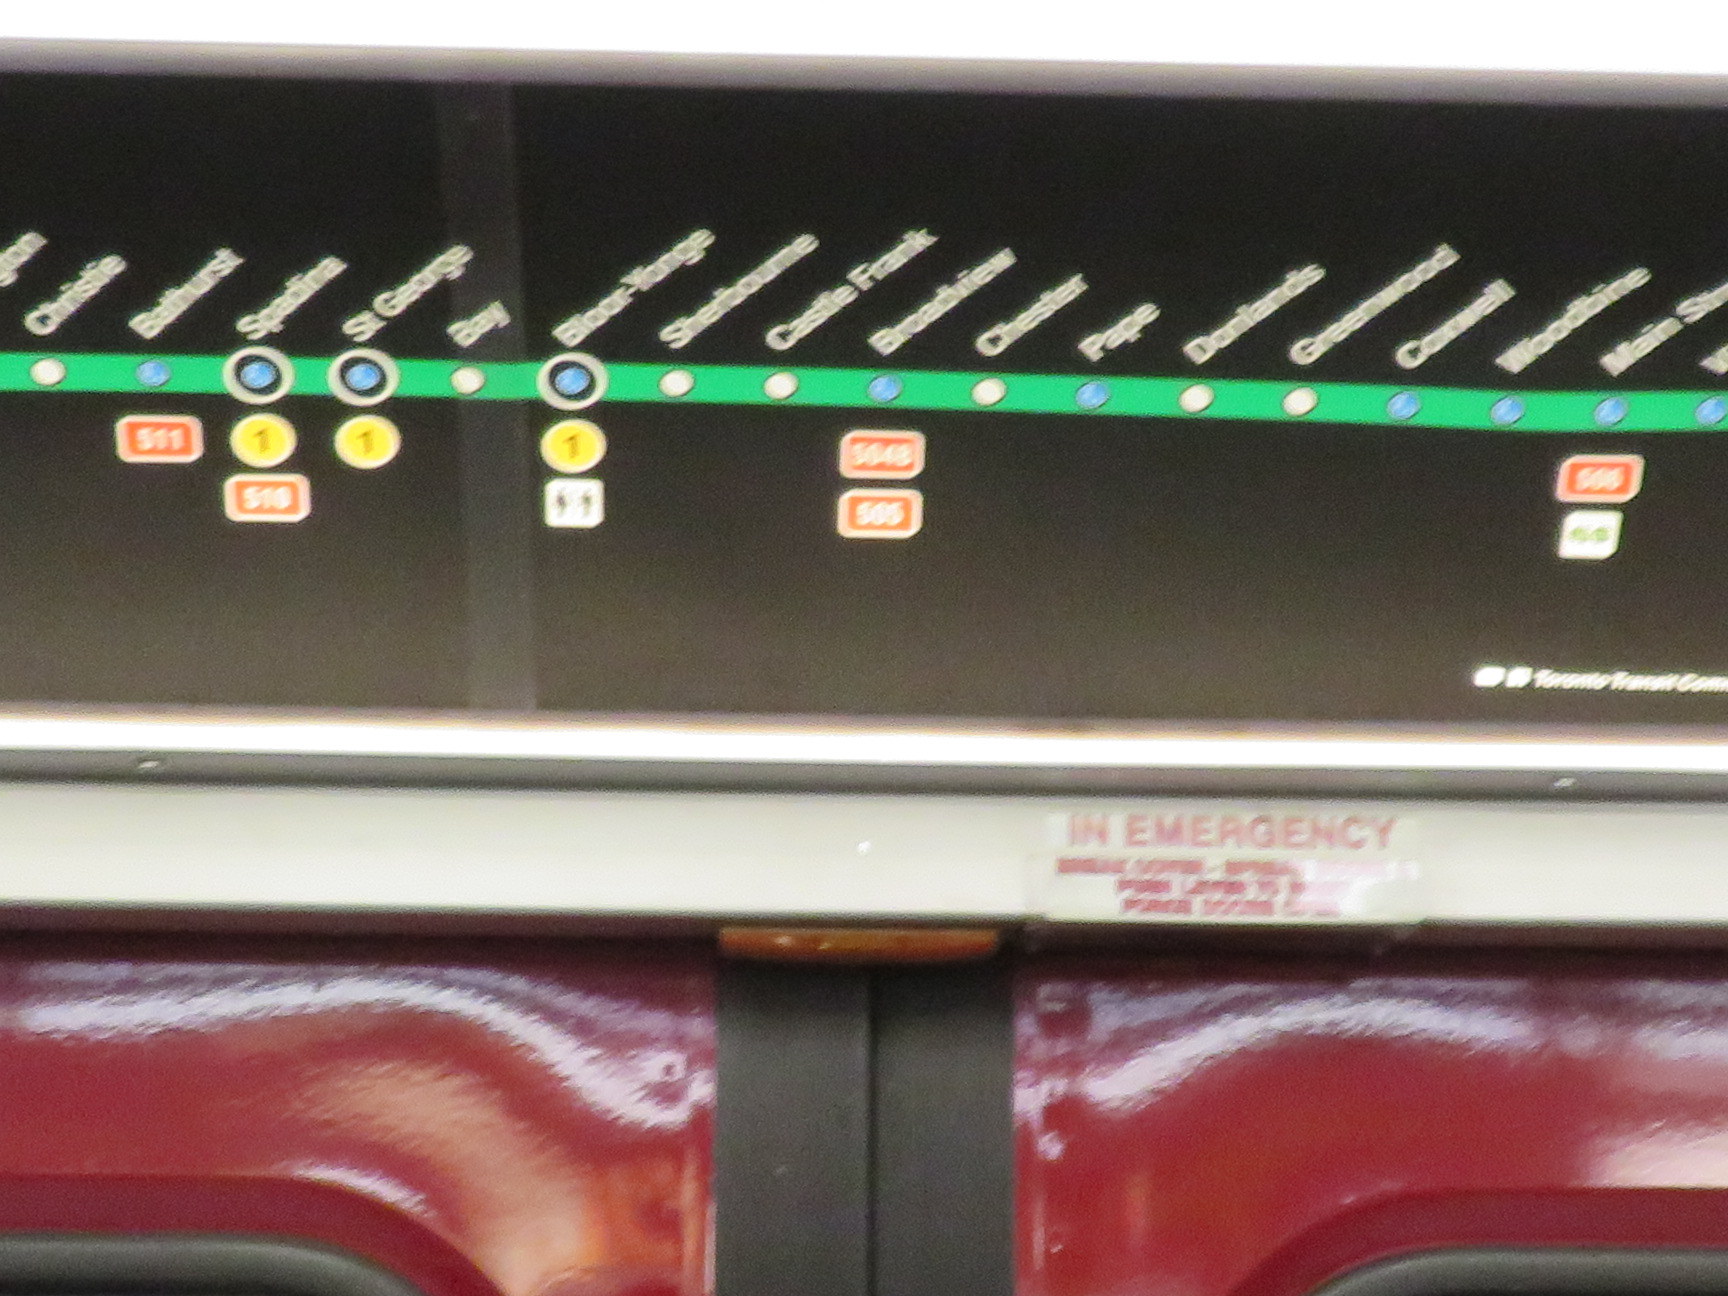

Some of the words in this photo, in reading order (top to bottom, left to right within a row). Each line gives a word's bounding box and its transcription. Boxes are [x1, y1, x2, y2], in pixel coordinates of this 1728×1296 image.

[138, 428, 183, 451] 511
[254, 429, 271, 454] 1
[357, 431, 376, 455] 1
[1067, 814, 1110, 847] IN
[1125, 814, 1398, 850] EMERGENCY
